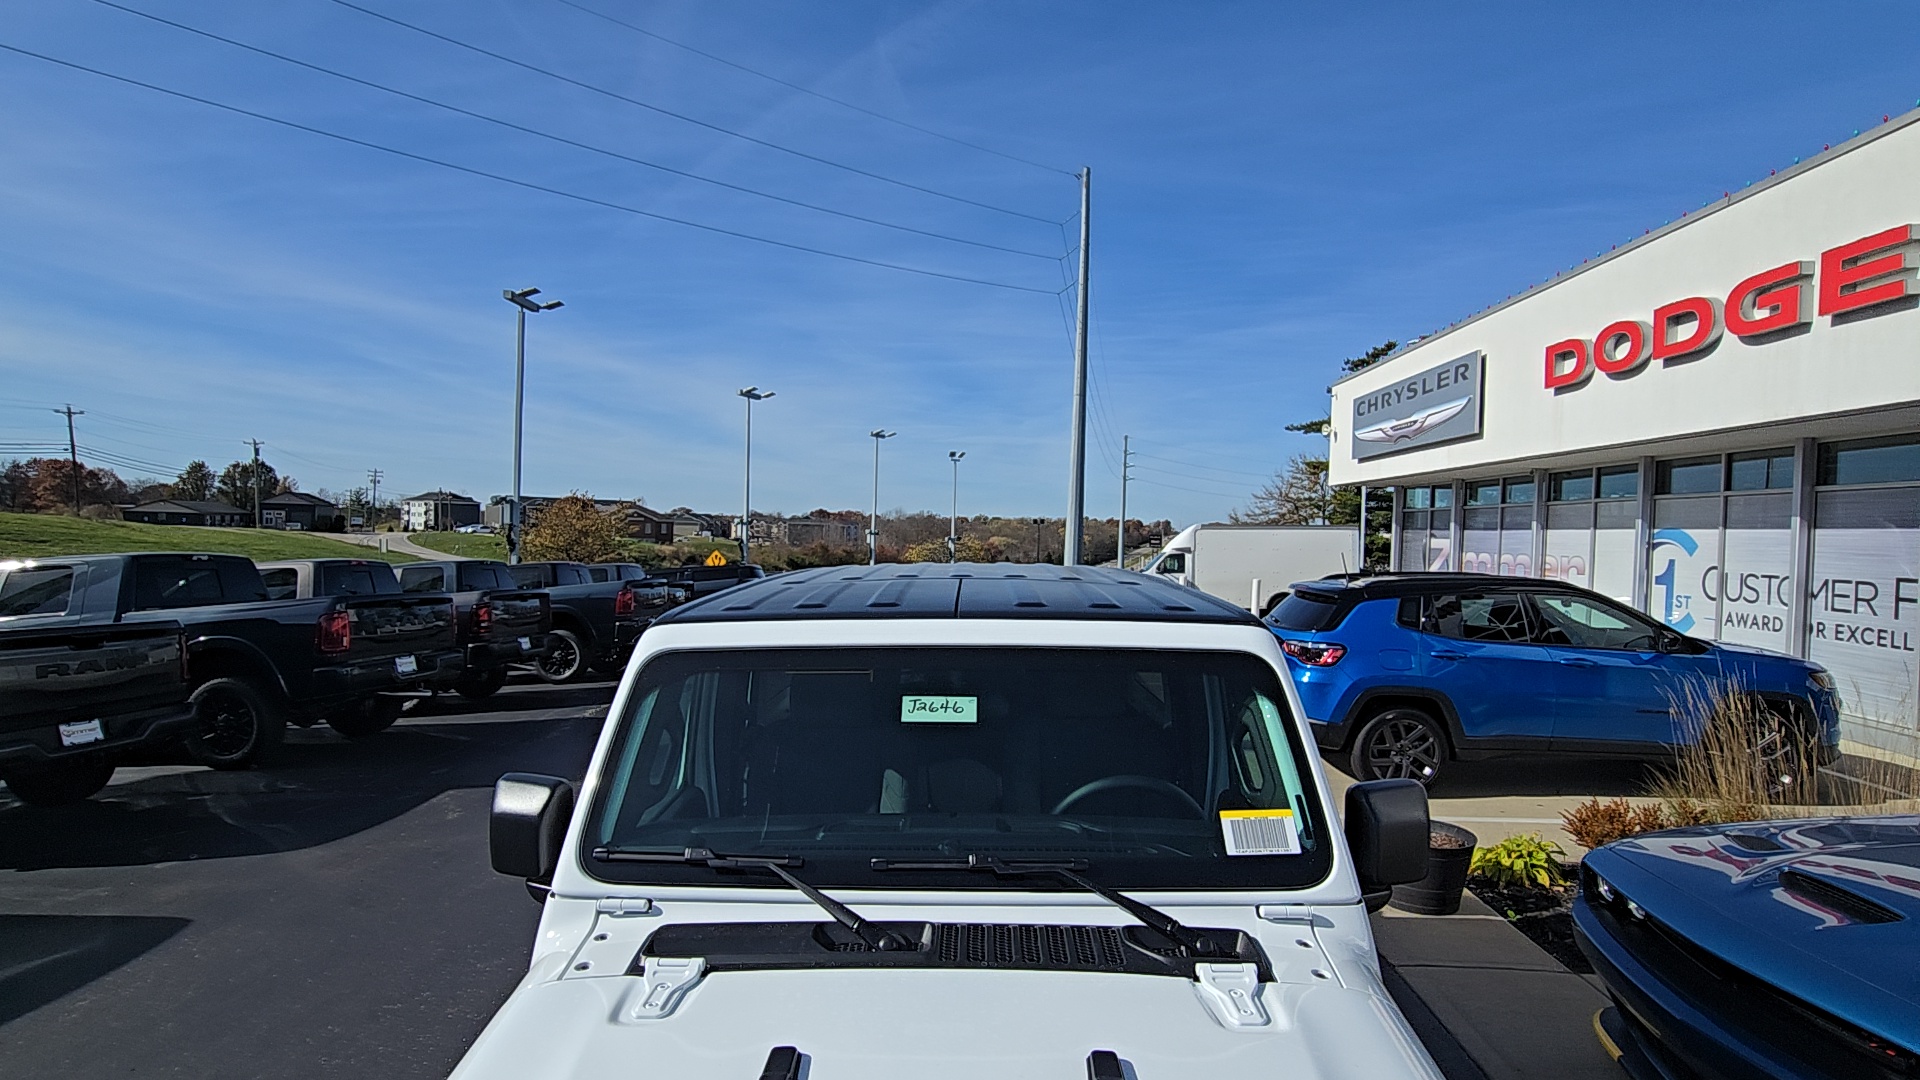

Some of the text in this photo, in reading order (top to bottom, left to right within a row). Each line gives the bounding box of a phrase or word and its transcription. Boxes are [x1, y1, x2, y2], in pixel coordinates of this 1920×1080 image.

[1544, 223, 1920, 390] DODGE
[1356, 362, 1470, 417] CHRYSLER
[1428, 537, 1586, 580] Zmmer
[1723, 611, 1784, 633] AWARD
[1834, 623, 1915, 652] EXCELL
[907, 698, 965, 714] J2646
